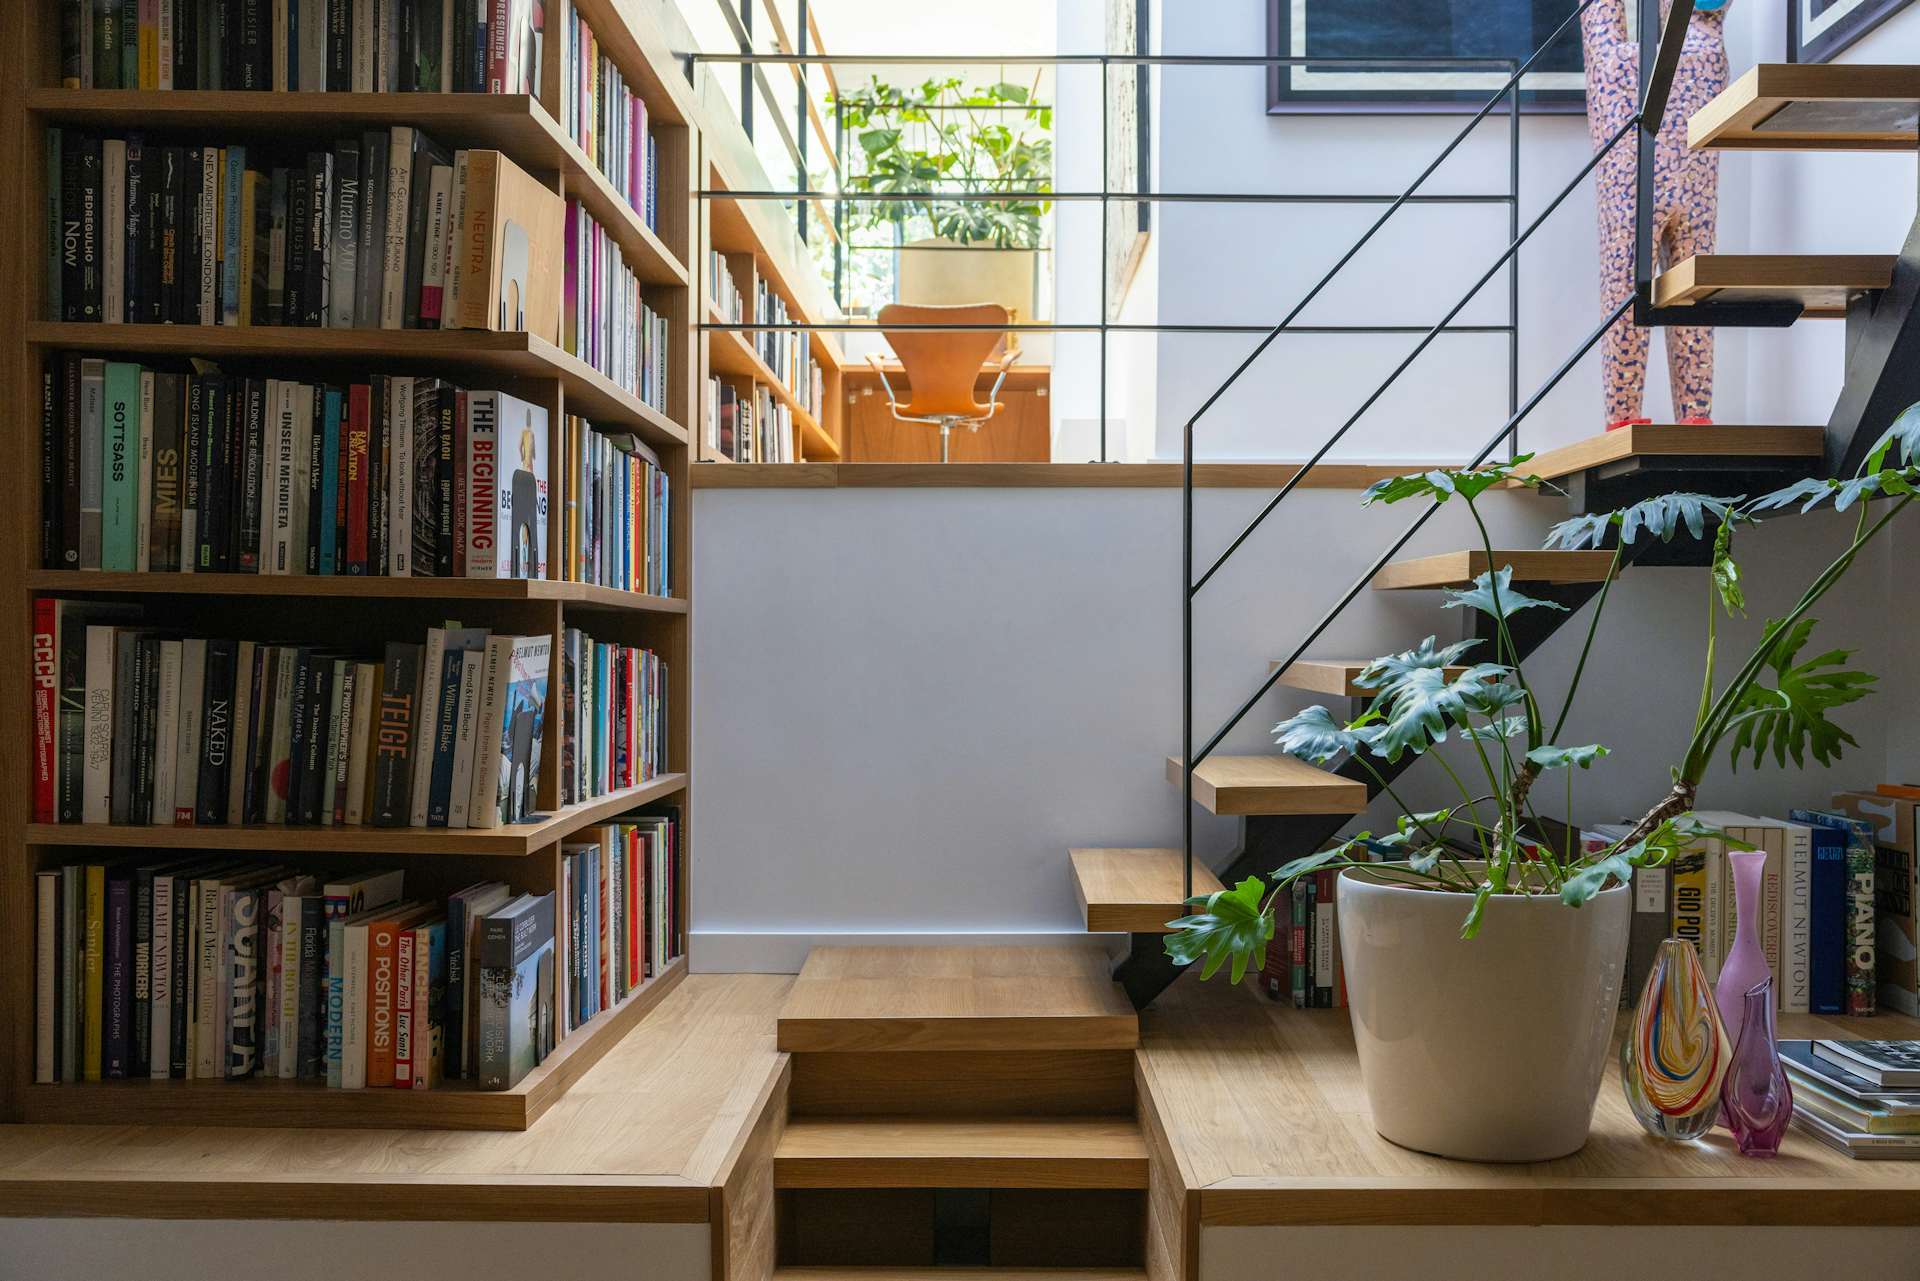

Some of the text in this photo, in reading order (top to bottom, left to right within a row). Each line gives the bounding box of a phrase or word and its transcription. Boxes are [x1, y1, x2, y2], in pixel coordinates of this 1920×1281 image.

[104, 17, 112, 50] Goldin
[84, 188, 95, 262] PEDREGULHO
[127, 165, 142, 237] Murano Magic
[203, 154, 215, 293] NEW ARCHITECTURE LONDON
[228, 159, 239, 248] German Photography
[312, 172, 324, 251] The Lost Vanguard
[338, 177, 359, 239] Murano
[294, 199, 304, 272] CORBUSIER
[393, 236, 405, 273] MURANO
[470, 210, 487, 275] NEUTRA
[397, 384, 408, 417] Wolfgang
[441, 408, 452, 432] vize
[111, 401, 127, 483] SOTTSASS
[187, 384, 201, 506] LONG ISLAND MODERNISM
[247, 391, 260, 499] BUILDING THE REVOLUTION
[278, 412, 293, 529] UNSEEN MENDIETA
[311, 434, 321, 491] Richard Meier
[349, 431, 358, 481] CREATION
[357, 431, 367, 455] RAW
[398, 461, 406, 477] look
[399, 451, 406, 460] To
[155, 448, 178, 515] MIES
[398, 478, 406, 505] without
[457, 477, 465, 505] NEVER
[472, 398, 495, 550] THE BEGINNING
[371, 500, 380, 539] Outsider Art
[398, 507, 406, 520] fear
[456, 530, 464, 556] AWAY
[33, 633, 57, 689] CCCP
[465, 663, 477, 687] Bernd
[488, 643, 498, 676] HELMUT
[292, 665, 308, 745] Antoine Predock
[439, 683, 457, 753] William Blake
[464, 695, 473, 711] Hilla
[485, 676, 495, 708] NEWTON
[89, 689, 100, 771] VENINI 1932-1947
[99, 689, 110, 763] CARLO SCARPA
[209, 699, 228, 767] NAKED
[309, 704, 321, 771] The Dancing Column
[327, 714, 340, 772] Picturing New York
[337, 675, 354, 784] THE PHOTOGRAPHER'S MIND
[377, 694, 413, 761] TEIGE
[461, 713, 472, 742] Becher
[482, 712, 494, 735] Pages
[482, 735, 490, 754] from
[480, 754, 490, 766] the
[204, 888, 217, 934] Richard
[1677, 887, 1701, 912] GIO
[1766, 873, 1779, 969] REDISCOVERED
[1793, 834, 1808, 998] HELMUT NEWTON
[1855, 872, 1875, 970] PIANO
[86, 919, 102, 973] Sander
[135, 887, 150, 999] SALGADO WORKERS
[153, 883, 170, 1002] HELMUT NEWTON
[175, 893, 186, 1007] THE WARHOL LOOK
[203, 937, 217, 972] Meier
[283, 922, 298, 1017] IN THE ROUGH
[304, 927, 318, 959] Florida
[448, 949, 461, 985] Vitebsk
[111, 961, 123, 1040] THE PHOTOGRAPHS
[399, 937, 411, 1009] The Other Paris
[328, 976, 344, 1061] MODERN
[398, 1013, 410, 1058] Luc Sante
[485, 1030, 496, 1064] WORK
